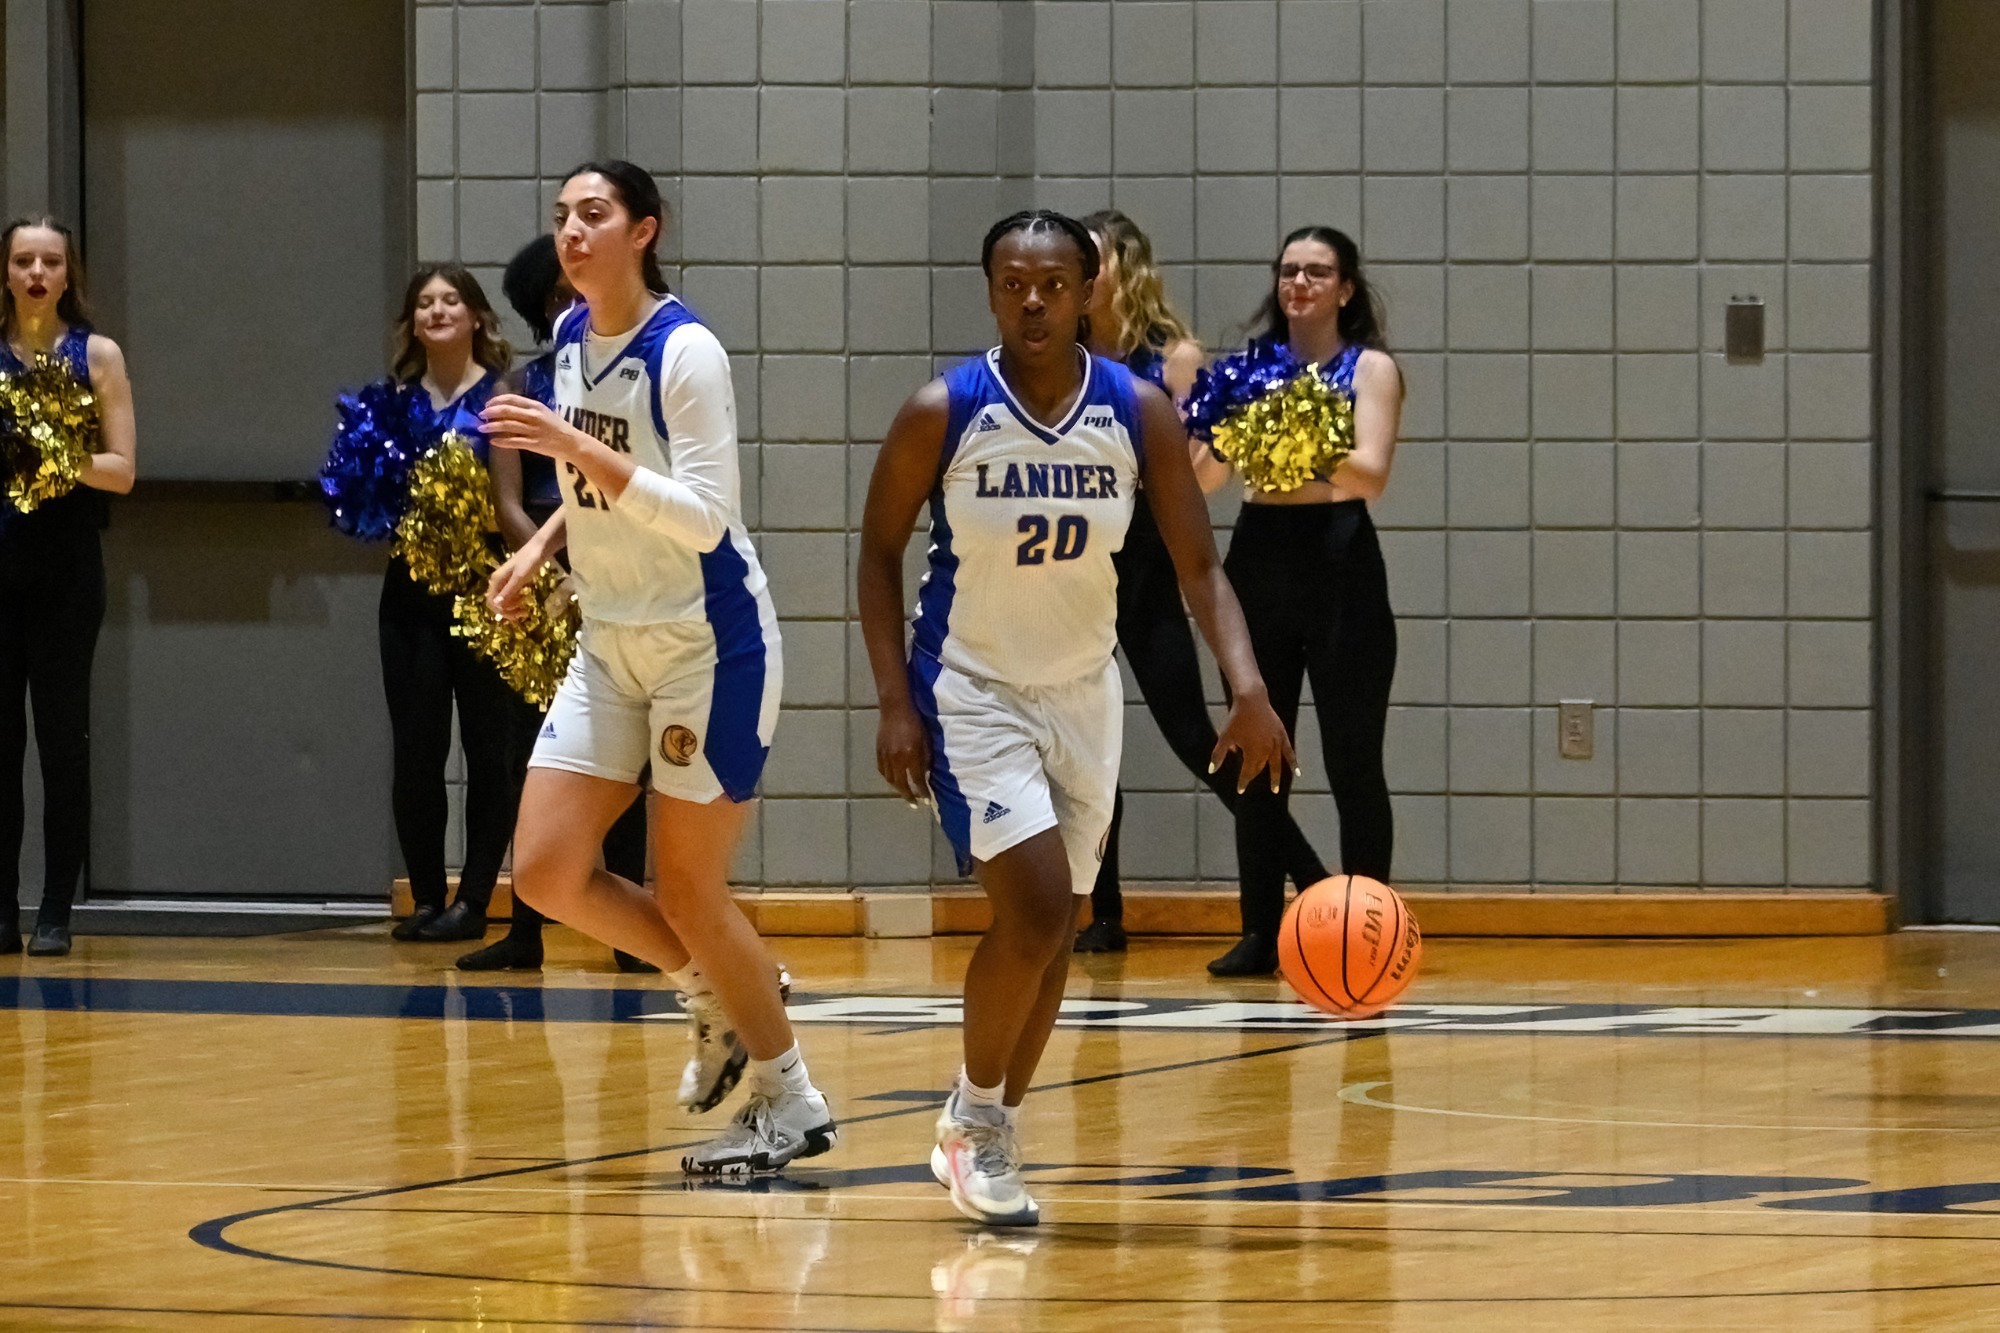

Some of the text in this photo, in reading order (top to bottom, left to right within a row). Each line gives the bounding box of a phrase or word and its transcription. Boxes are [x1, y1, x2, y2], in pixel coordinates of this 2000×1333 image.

[558, 404, 631, 453] ANDER
[976, 462, 1119, 499] LANDER
[1016, 514, 1088, 566] 20
